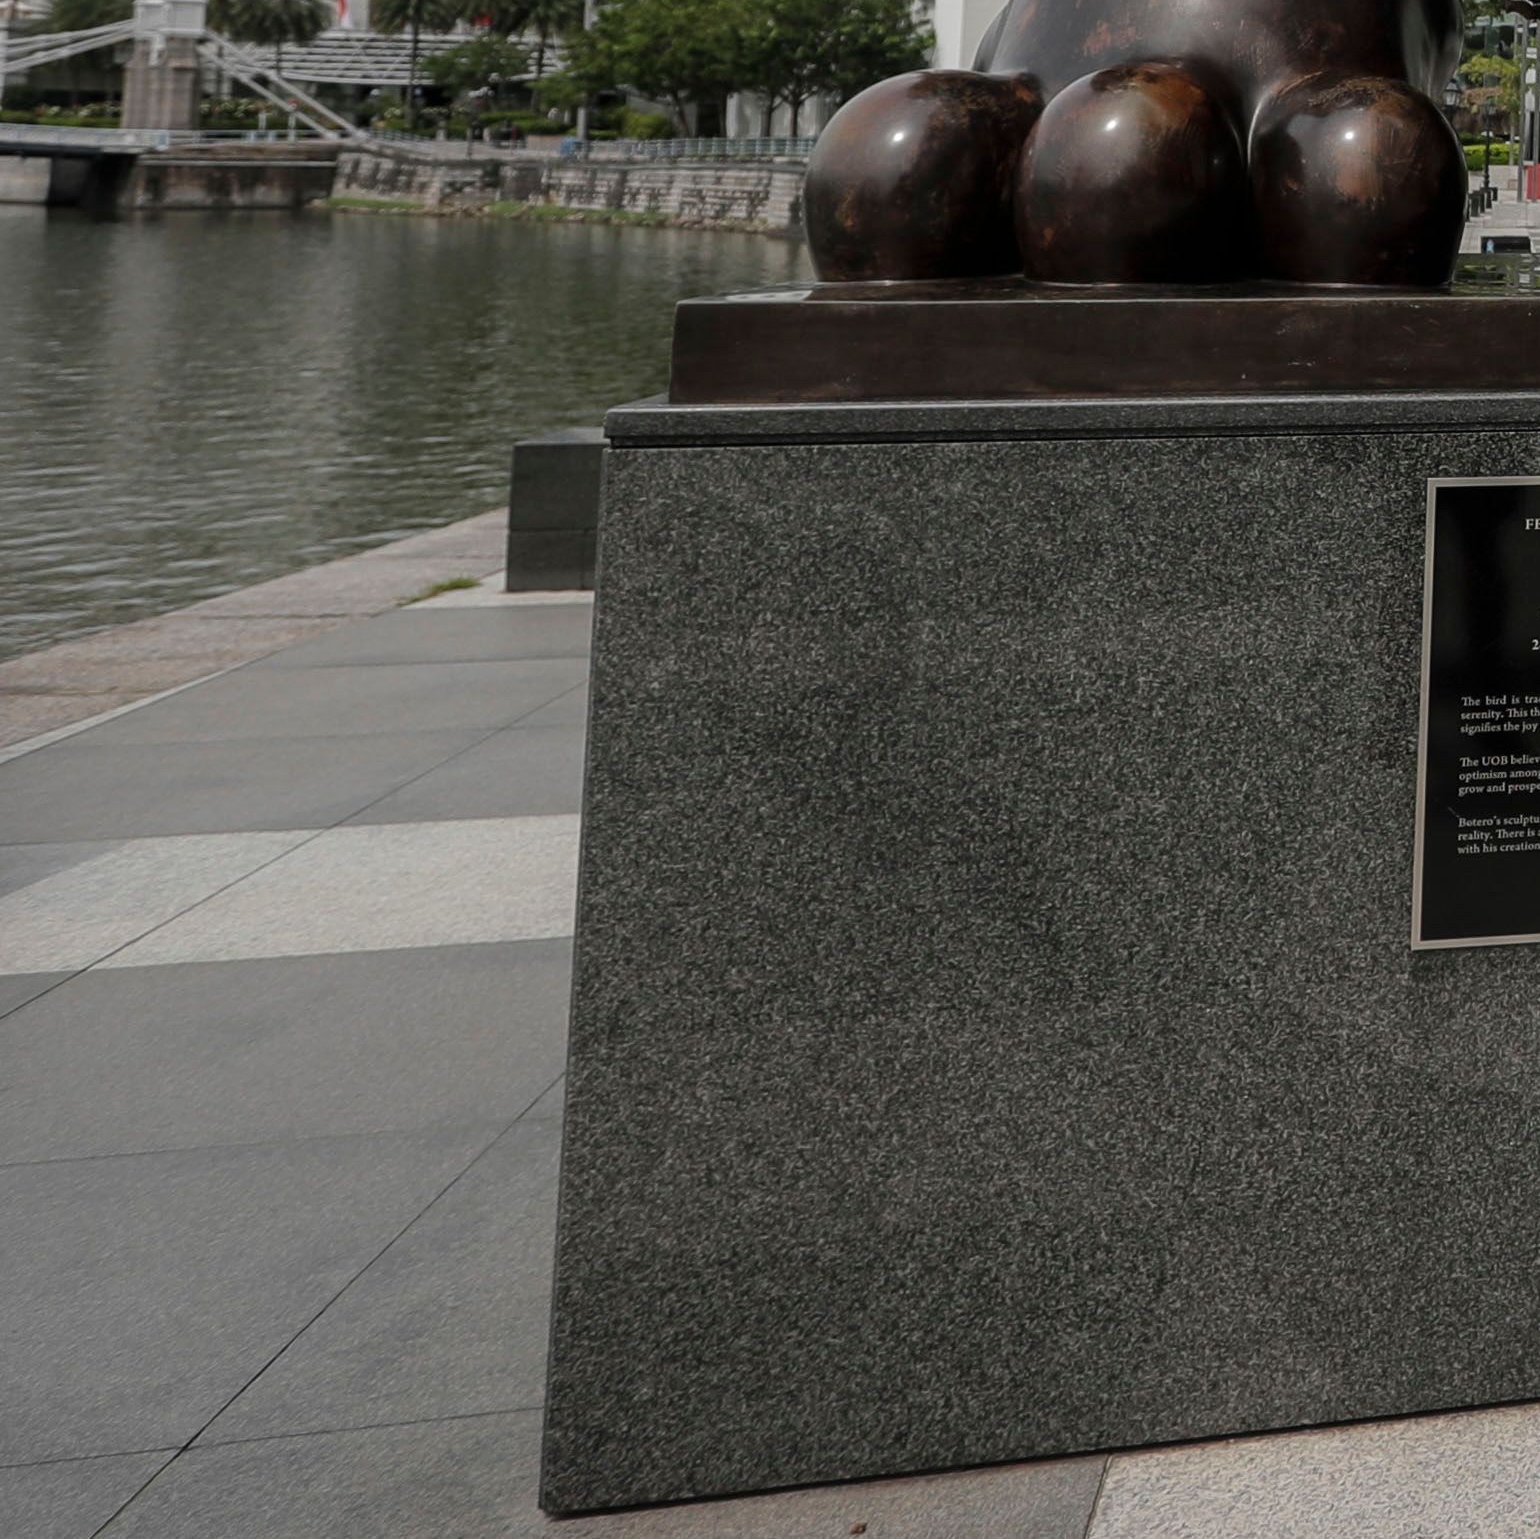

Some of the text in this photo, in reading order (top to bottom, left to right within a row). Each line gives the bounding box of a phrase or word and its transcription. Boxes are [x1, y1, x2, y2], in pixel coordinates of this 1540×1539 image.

[1461, 696, 1481, 706] The
[1485, 695, 1506, 705] bird
[1512, 695, 1520, 704] is
[1460, 709, 1504, 721] serenity.
[1507, 708, 1528, 718] This
[1460, 722, 1501, 736] signifies
[1503, 721, 1520, 731] the
[1522, 720, 1538, 733] joy
[1460, 757, 1479, 767] The
[1481, 755, 1508, 766] UOB
[1458, 769, 1507, 782] optimism
[1458, 784, 1485, 797] grow
[1486, 782, 1506, 793] and
[1457, 829, 1493, 842] reality.
[1495, 828, 1525, 839] There
[1527, 828, 1535, 837] is
[1457, 844, 1480, 854] with
[1482, 843, 1498, 853] his
[1499, 841, 1540, 852] creation
